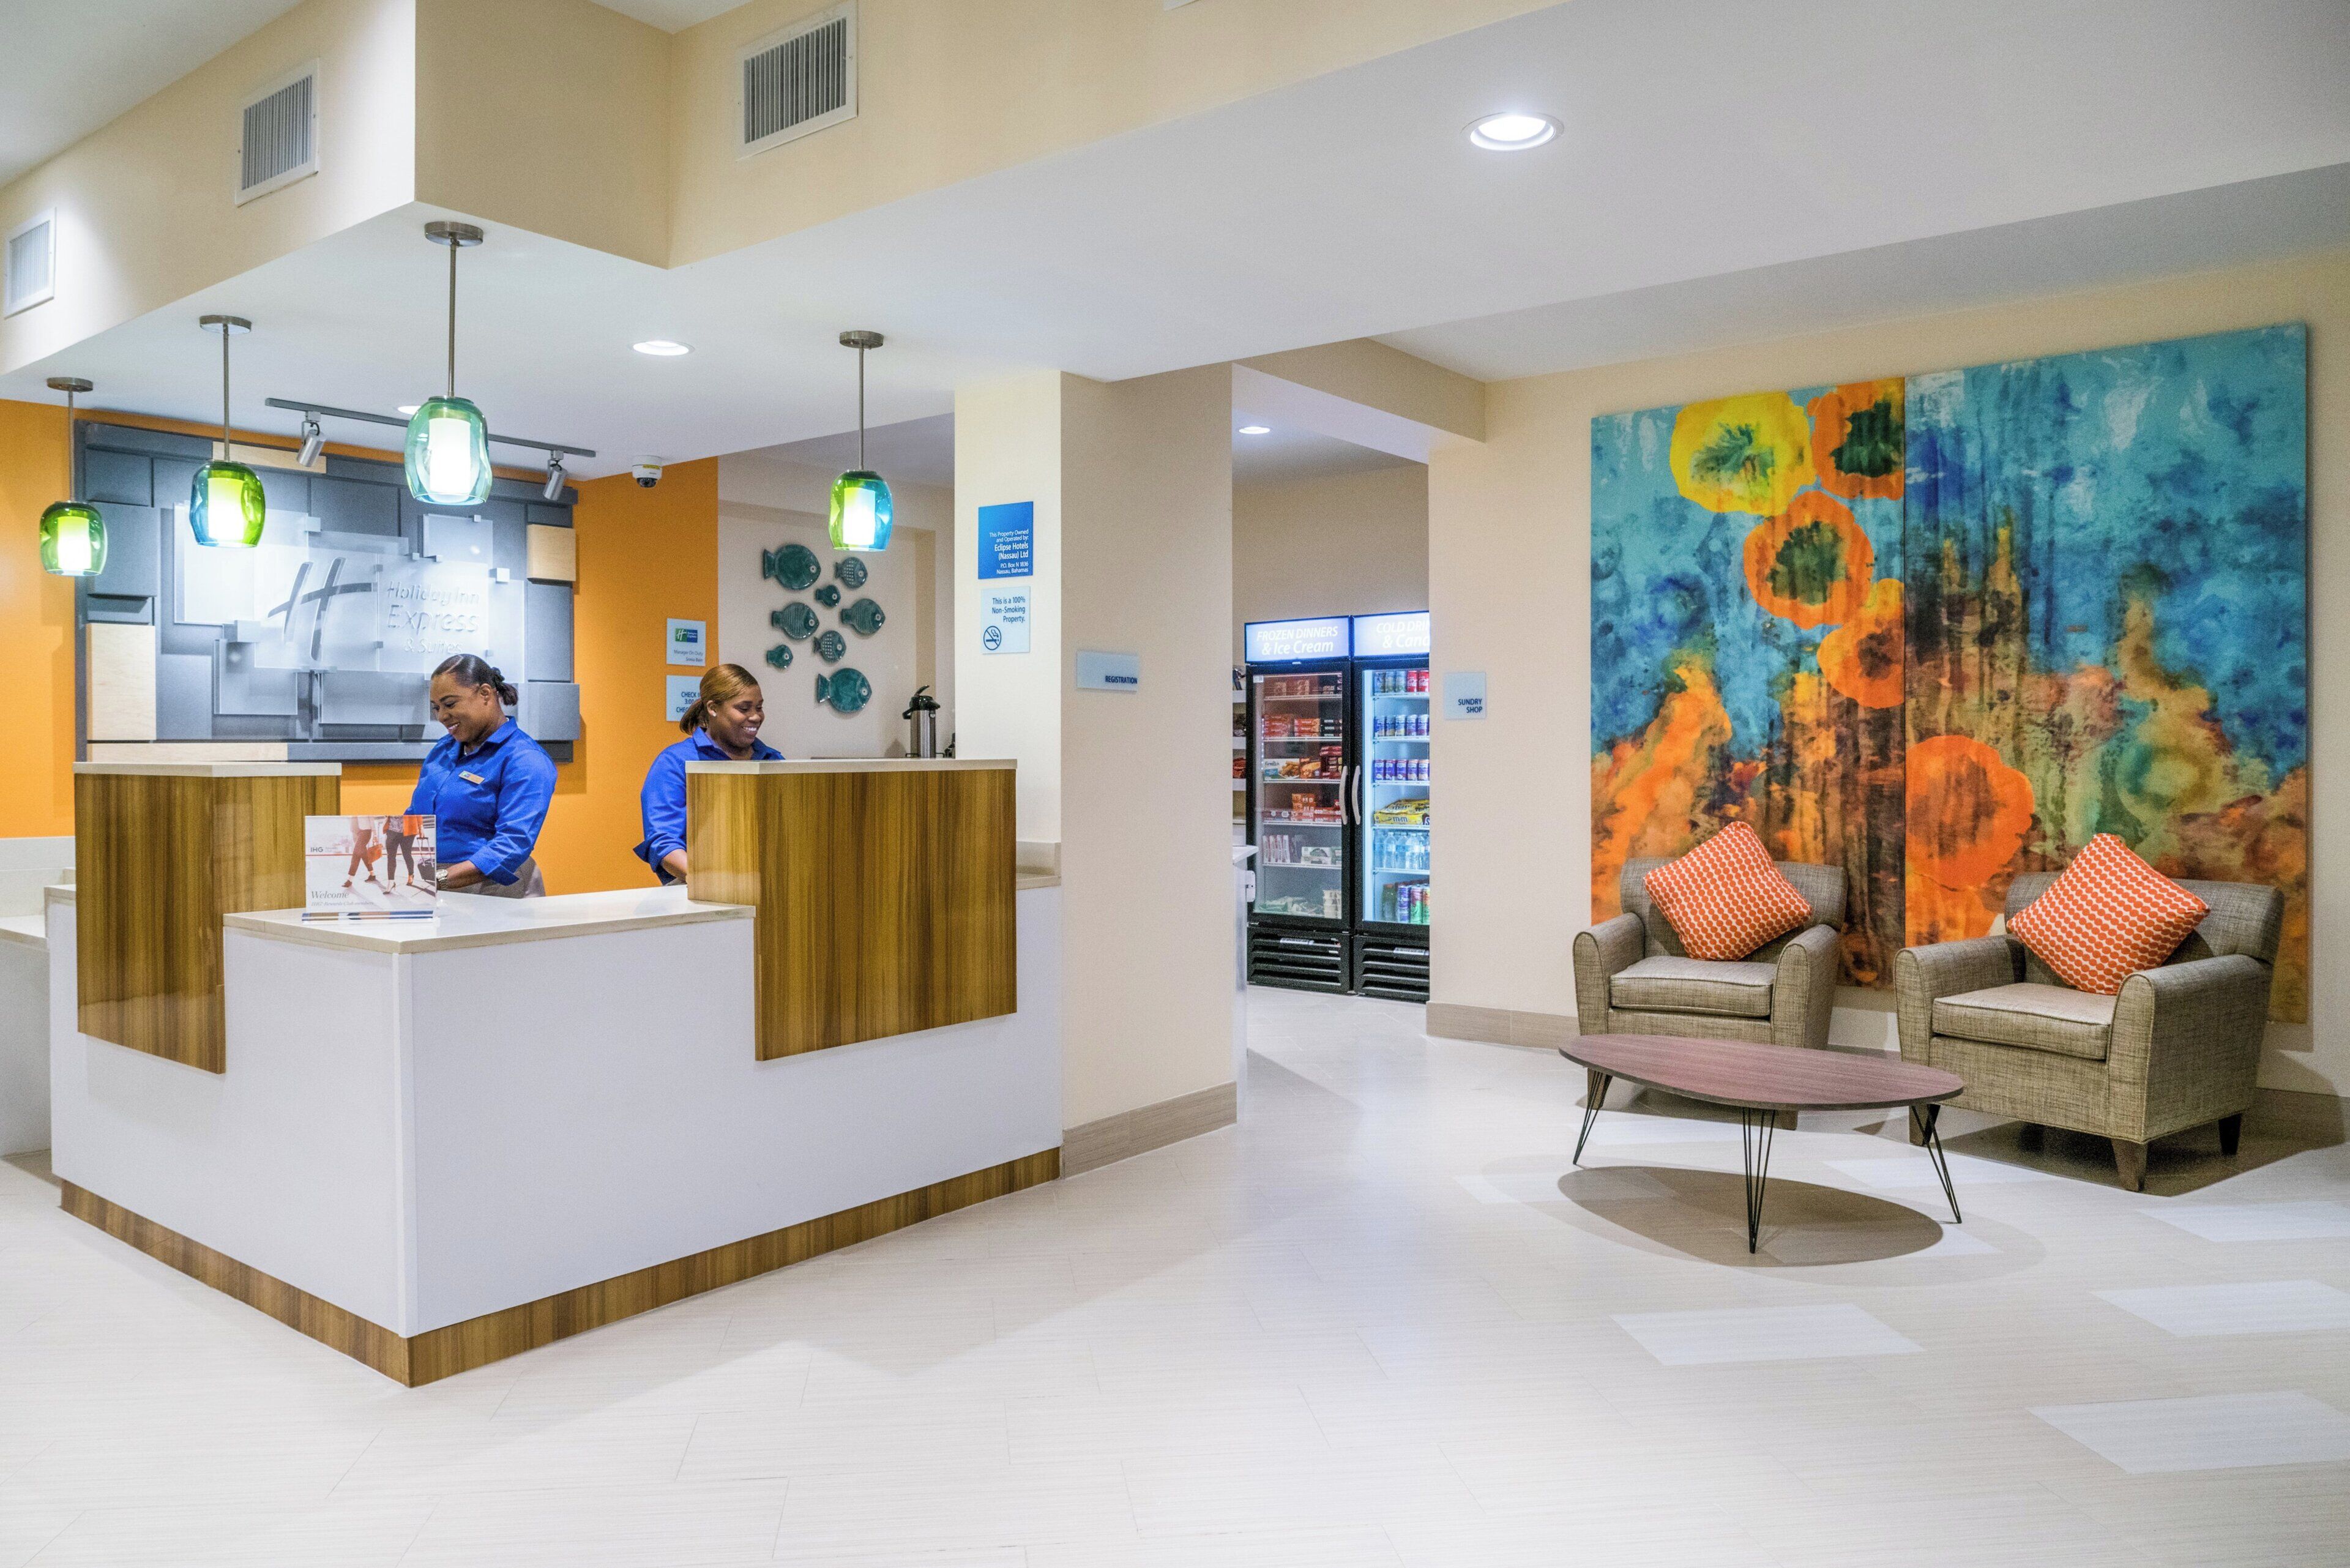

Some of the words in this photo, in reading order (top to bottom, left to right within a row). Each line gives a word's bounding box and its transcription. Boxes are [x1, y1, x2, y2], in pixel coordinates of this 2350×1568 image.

[994, 543, 1011, 552] Eclipse
[1012, 542, 1029, 550] Hotels
[998, 551, 1019, 561] (Nassau)
[387, 581, 450, 606] Holiday
[455, 587, 479, 604] Inn
[387, 604, 479, 635] Express
[1003, 615, 1026, 624] Property.
[1376, 621, 1405, 633] COLD
[1256, 629, 1294, 641] FROZEN
[1296, 626, 1338, 639] DINNERS
[417, 638, 462, 654] Suites
[1262, 642, 1271, 655] &
[1273, 642, 1291, 655] Ice
[1293, 640, 1334, 654] Cream
[1382, 635, 1393, 648] &
[1105, 675, 1138, 684] REGISTRATION
[311, 890, 349, 899] Welcome
